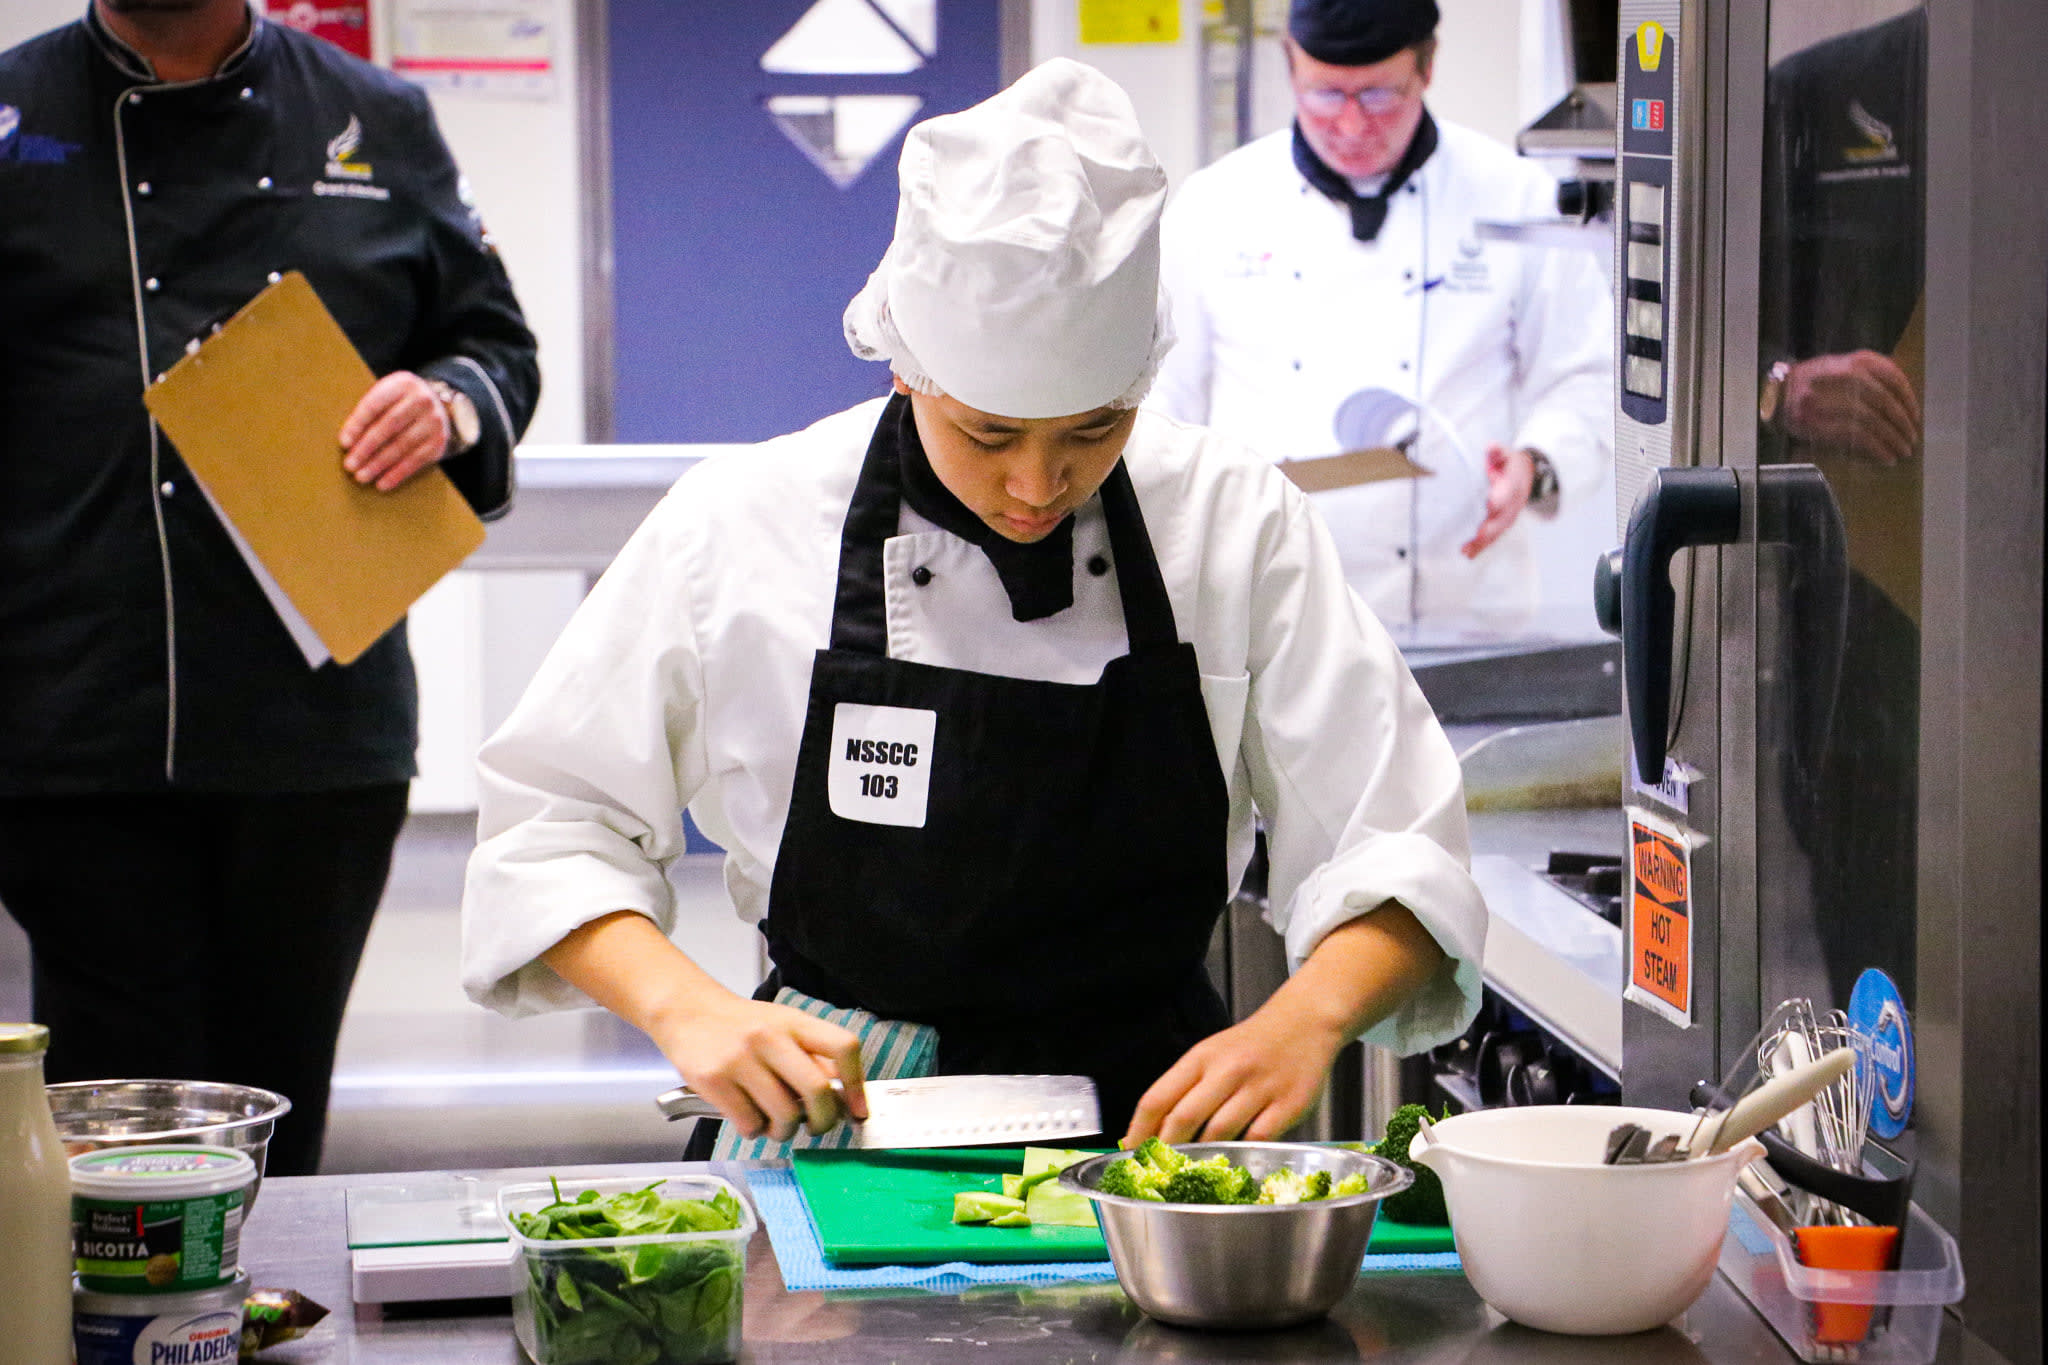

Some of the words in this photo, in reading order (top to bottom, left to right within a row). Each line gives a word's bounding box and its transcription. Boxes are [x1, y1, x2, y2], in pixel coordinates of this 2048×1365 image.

[846, 738, 918, 767] NSSCC
[860, 773, 899, 799] 103
[1638, 847, 1683, 897] WARNING
[1651, 910, 1671, 946] HOT
[1644, 949, 1677, 993] STEAM
[83, 1241, 149, 1258] RICOTTA
[189, 1327, 230, 1342] ORIGINAL
